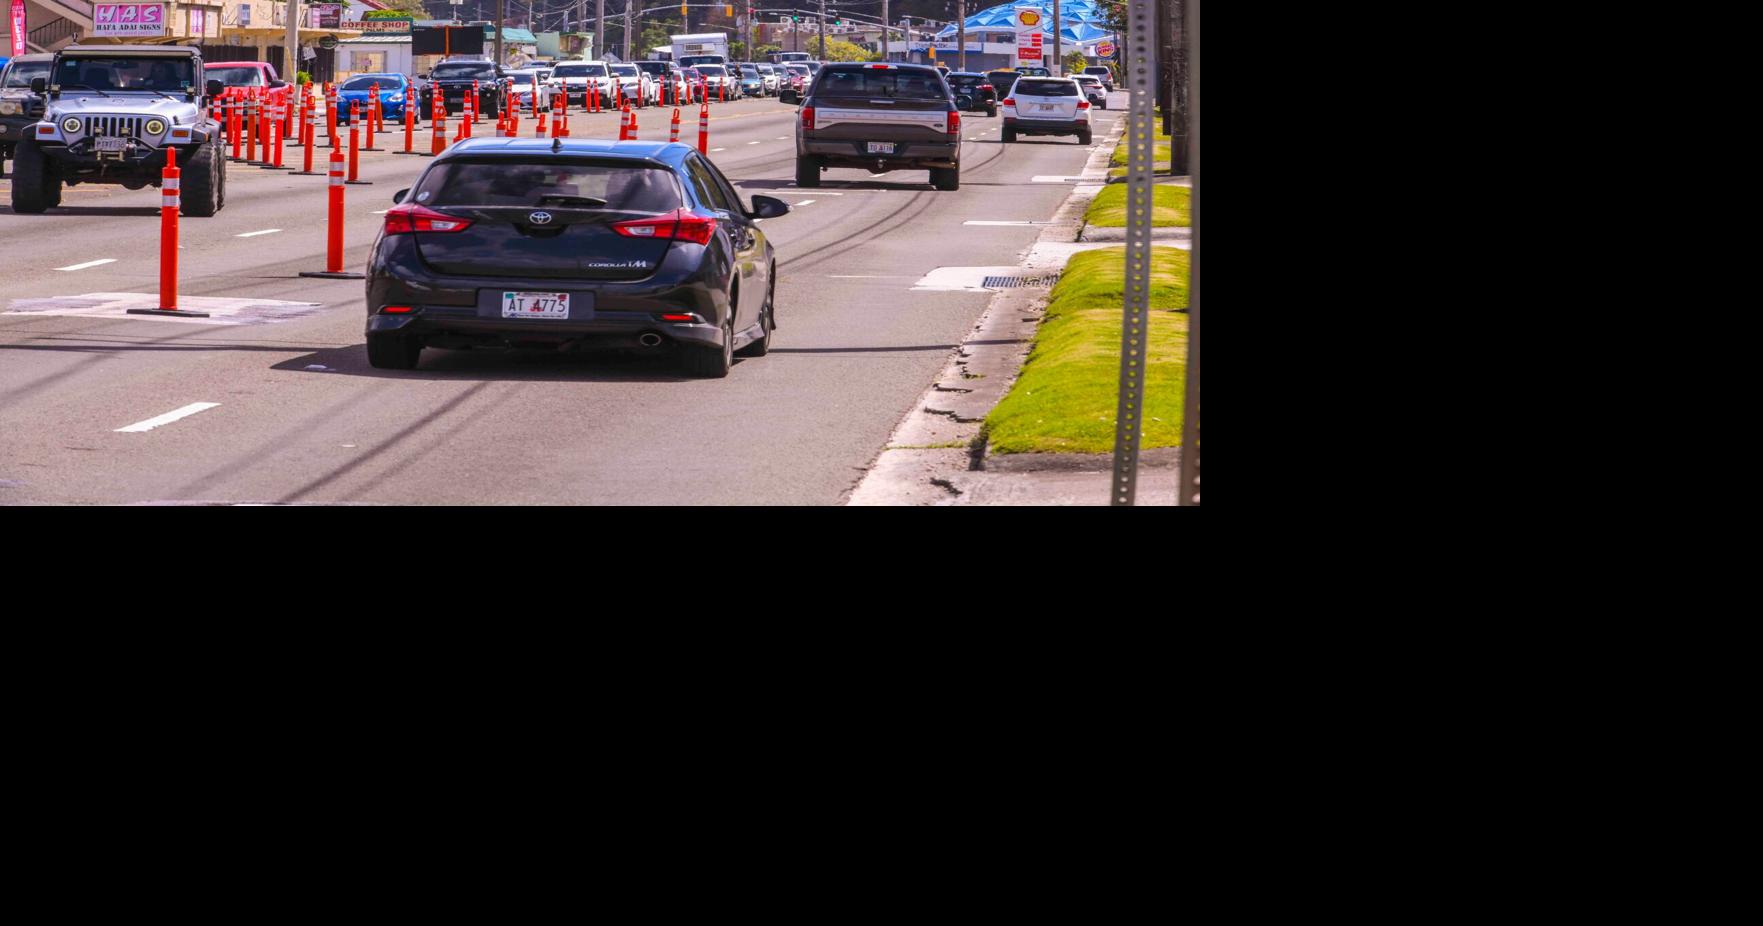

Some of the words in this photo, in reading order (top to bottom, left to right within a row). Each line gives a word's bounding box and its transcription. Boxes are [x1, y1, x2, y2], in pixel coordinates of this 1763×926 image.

[98, 6, 160, 22] HAS
[508, 299, 525, 312] AT
[533, 299, 567, 313] 4775
